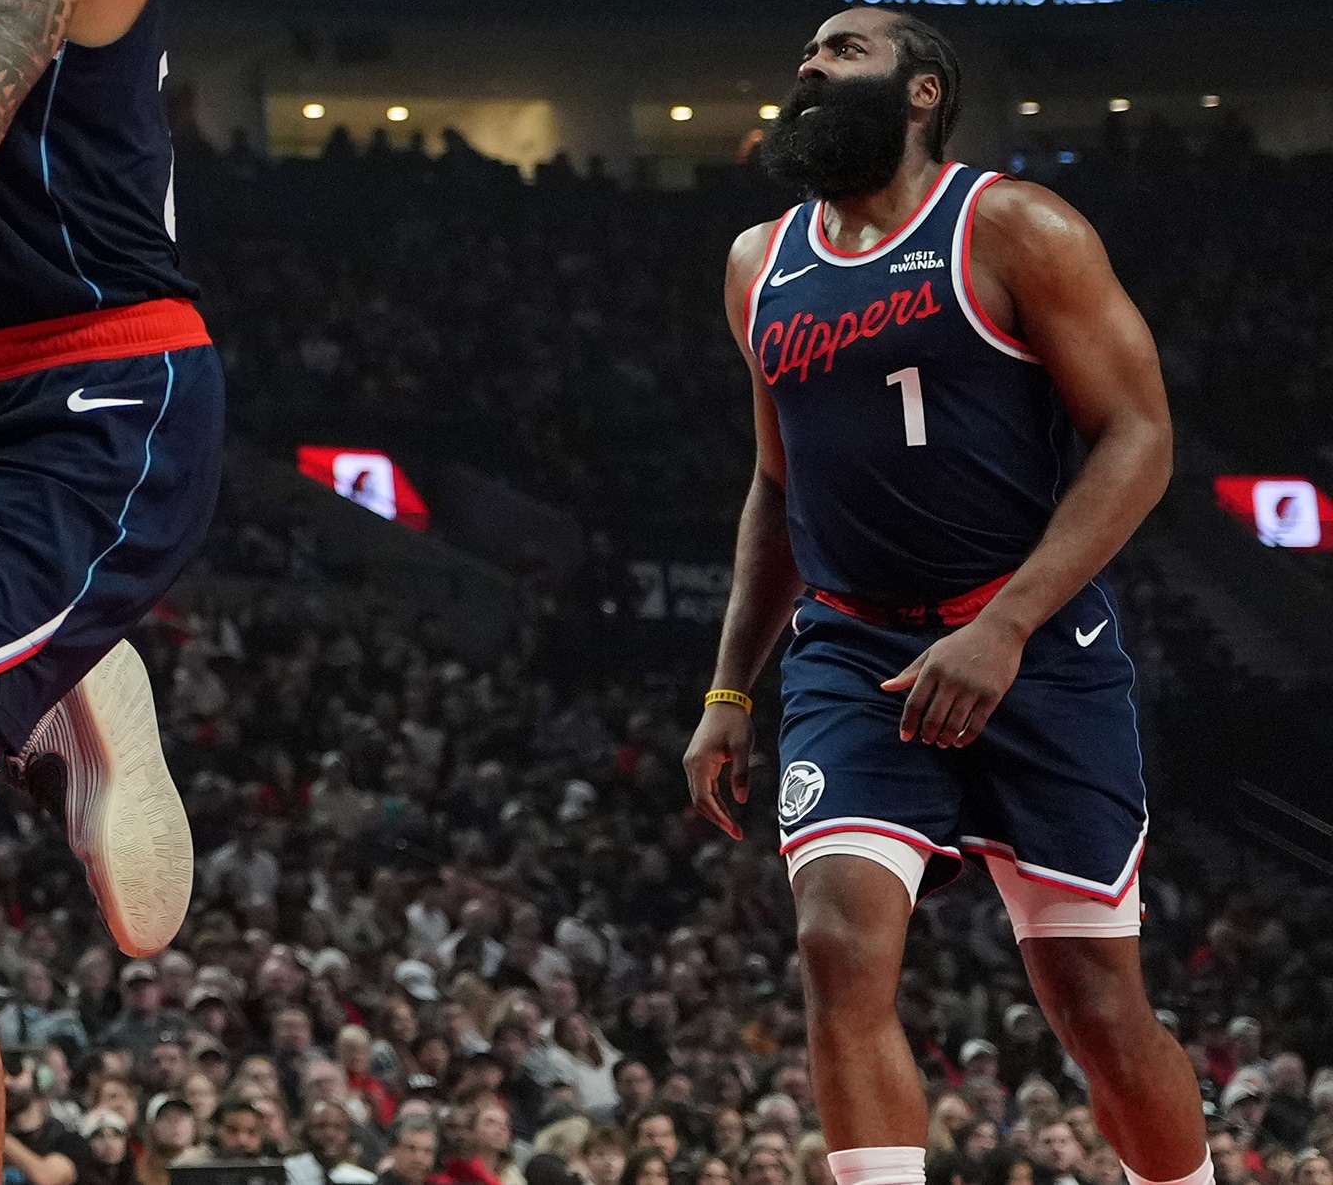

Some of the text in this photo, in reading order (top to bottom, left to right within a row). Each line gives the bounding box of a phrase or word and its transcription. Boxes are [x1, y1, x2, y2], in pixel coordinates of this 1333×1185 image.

[890, 258, 945, 274] RWANDA
[903, 250, 935, 263] VISIT
[759, 280, 942, 385] Clippers
[886, 367, 927, 446] 1
